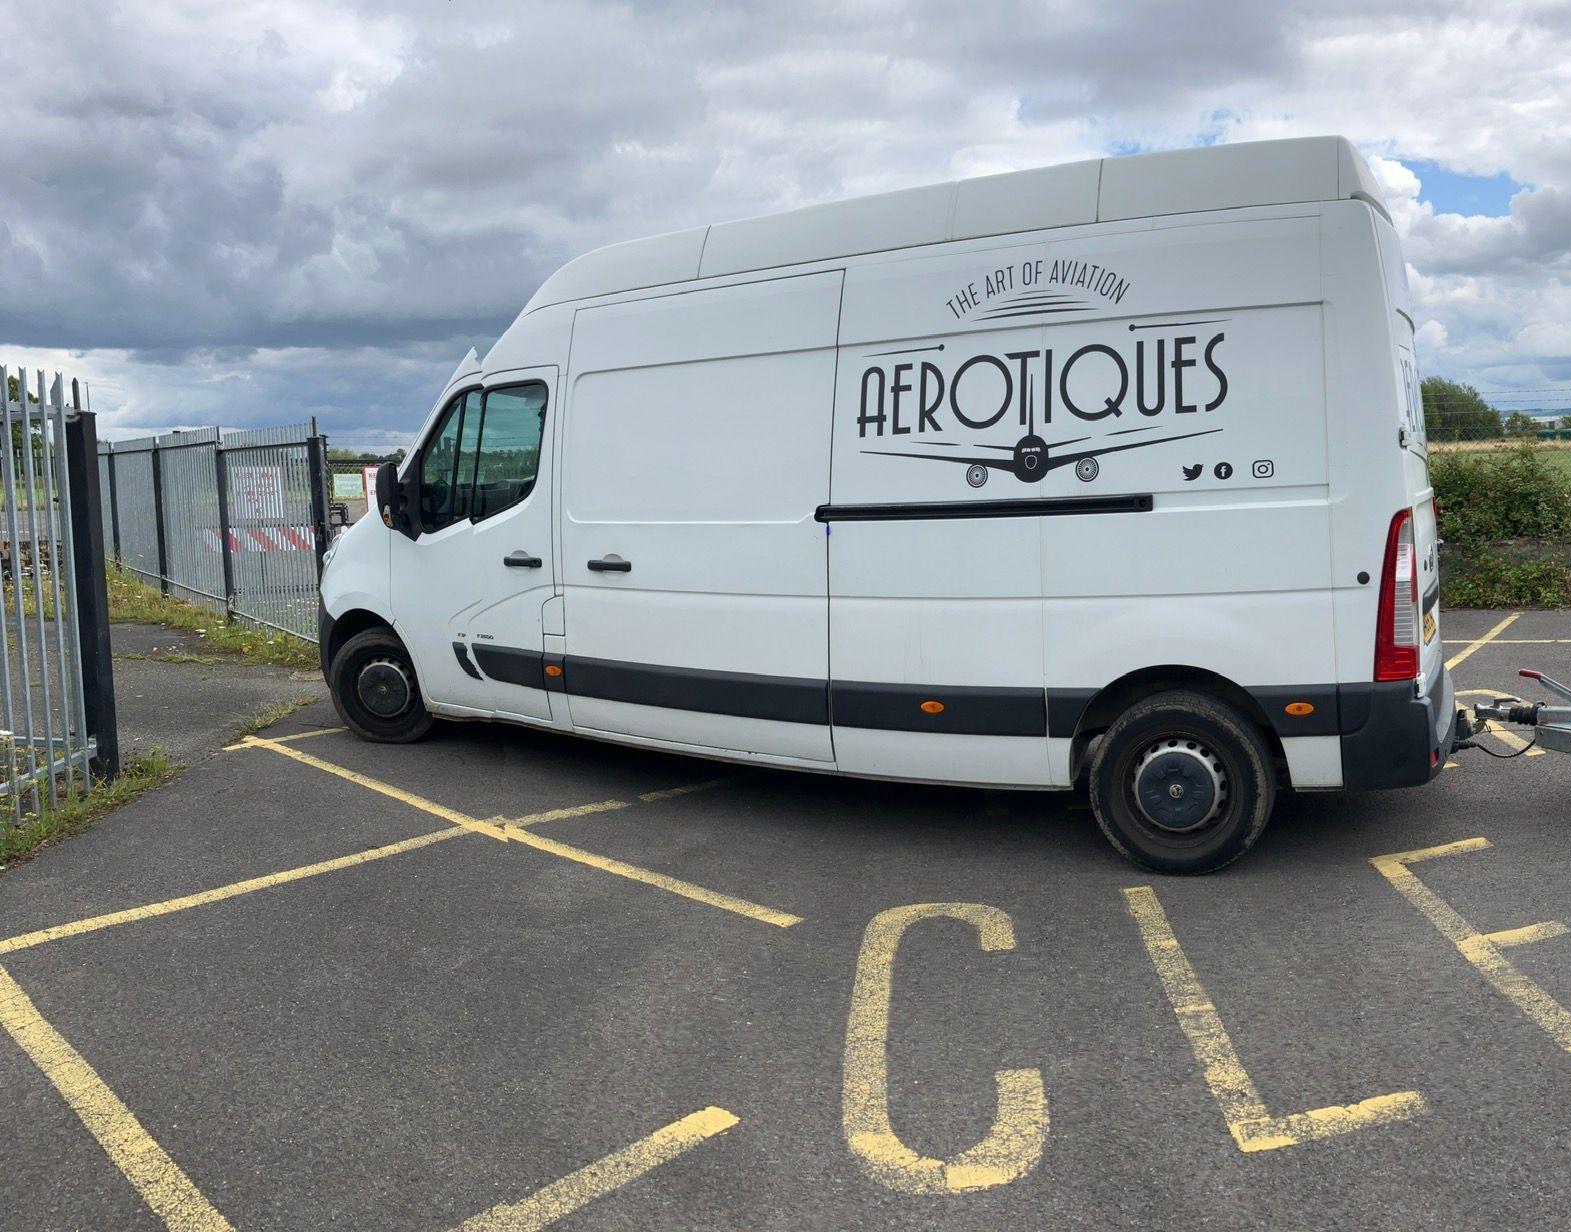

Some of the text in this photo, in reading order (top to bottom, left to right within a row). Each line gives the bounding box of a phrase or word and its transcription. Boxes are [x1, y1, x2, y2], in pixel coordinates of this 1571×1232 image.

[945, 259, 1131, 319] THE ART OF AVIATION
[856, 332, 1229, 438] AEROTIQUES
